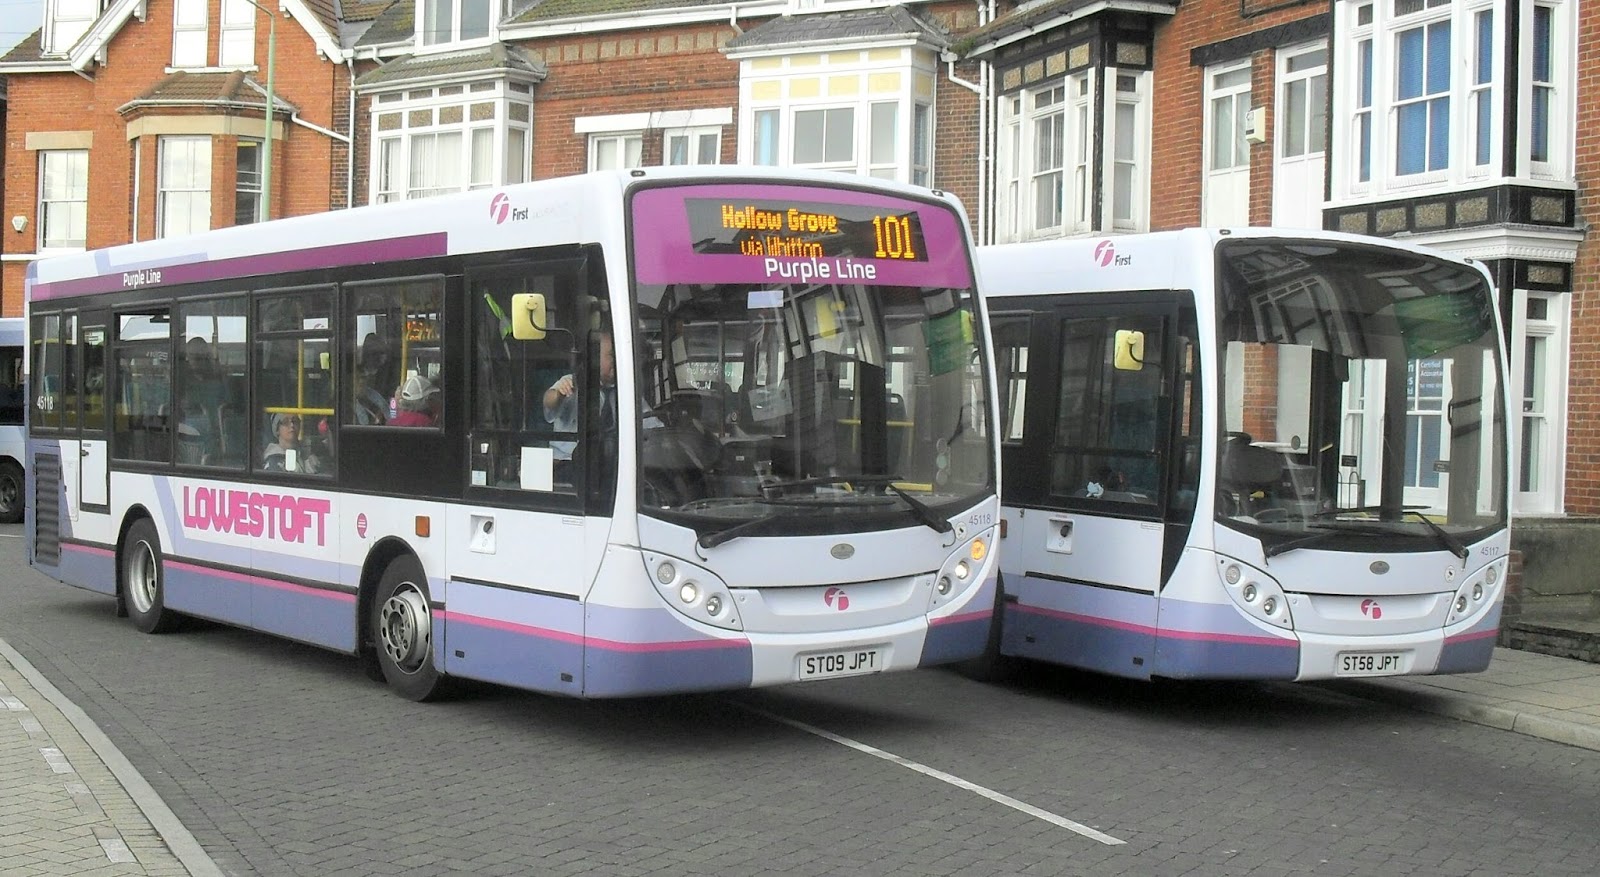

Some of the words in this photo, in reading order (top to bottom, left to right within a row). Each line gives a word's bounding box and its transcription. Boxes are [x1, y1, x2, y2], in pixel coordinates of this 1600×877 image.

[512, 207, 528, 221] First
[721, 205, 782, 231] Hollow
[787, 208, 838, 233] Grove
[741, 236, 765, 256] via
[872, 215, 915, 259] 101
[764, 257, 831, 283] Purple
[836, 259, 877, 280] Line
[1114, 254, 1131, 266] First
[123, 269, 145, 289] Purple
[146, 269, 161, 284] Line
[36, 395, 54, 410] 45118
[183, 485, 331, 546] LOWESTOFT
[968, 513, 992, 526] 45118
[1480, 546, 1500, 556] 45117
[806, 654, 845, 674] ST09
[849, 651, 876, 670] JPT
[1343, 656, 1374, 671] ST58
[1376, 655, 1399, 671] JPT
